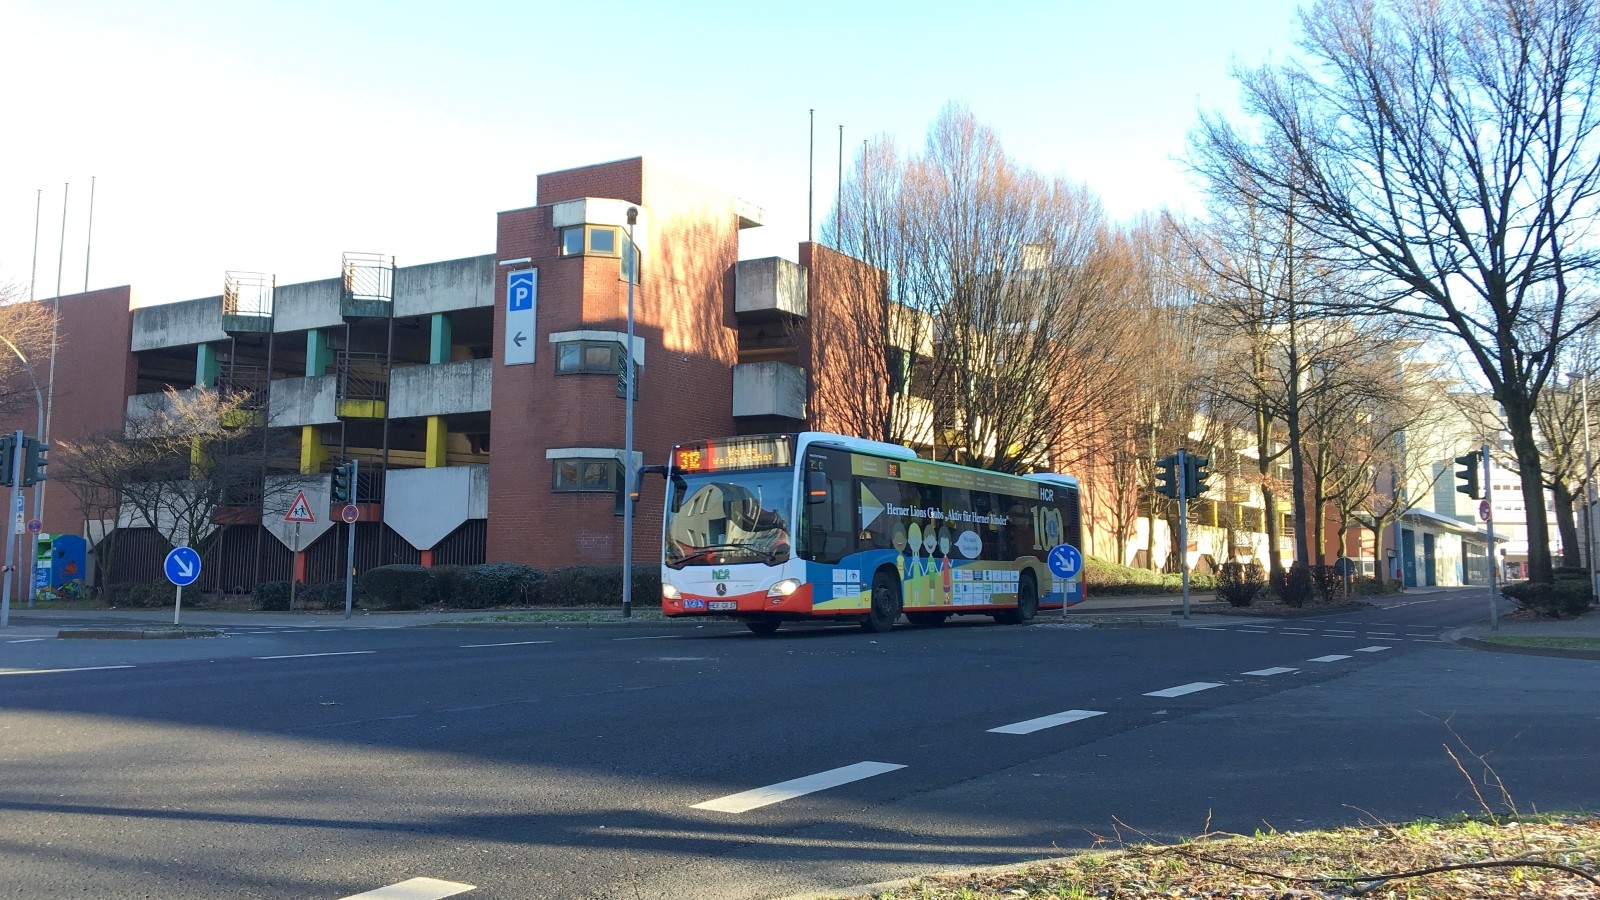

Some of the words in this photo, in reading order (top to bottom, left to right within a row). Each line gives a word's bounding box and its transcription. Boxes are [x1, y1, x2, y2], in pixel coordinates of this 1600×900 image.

[516, 287, 528, 307] P
[1040, 488, 1054, 502] HCR
[886, 502, 909, 516] Herner
[910, 504, 927, 518] Lions
[927, 507, 944, 520] Clubs
[963, 510, 971, 522] für
[971, 511, 989, 524] Herner
[1031, 505, 1064, 552] 100
